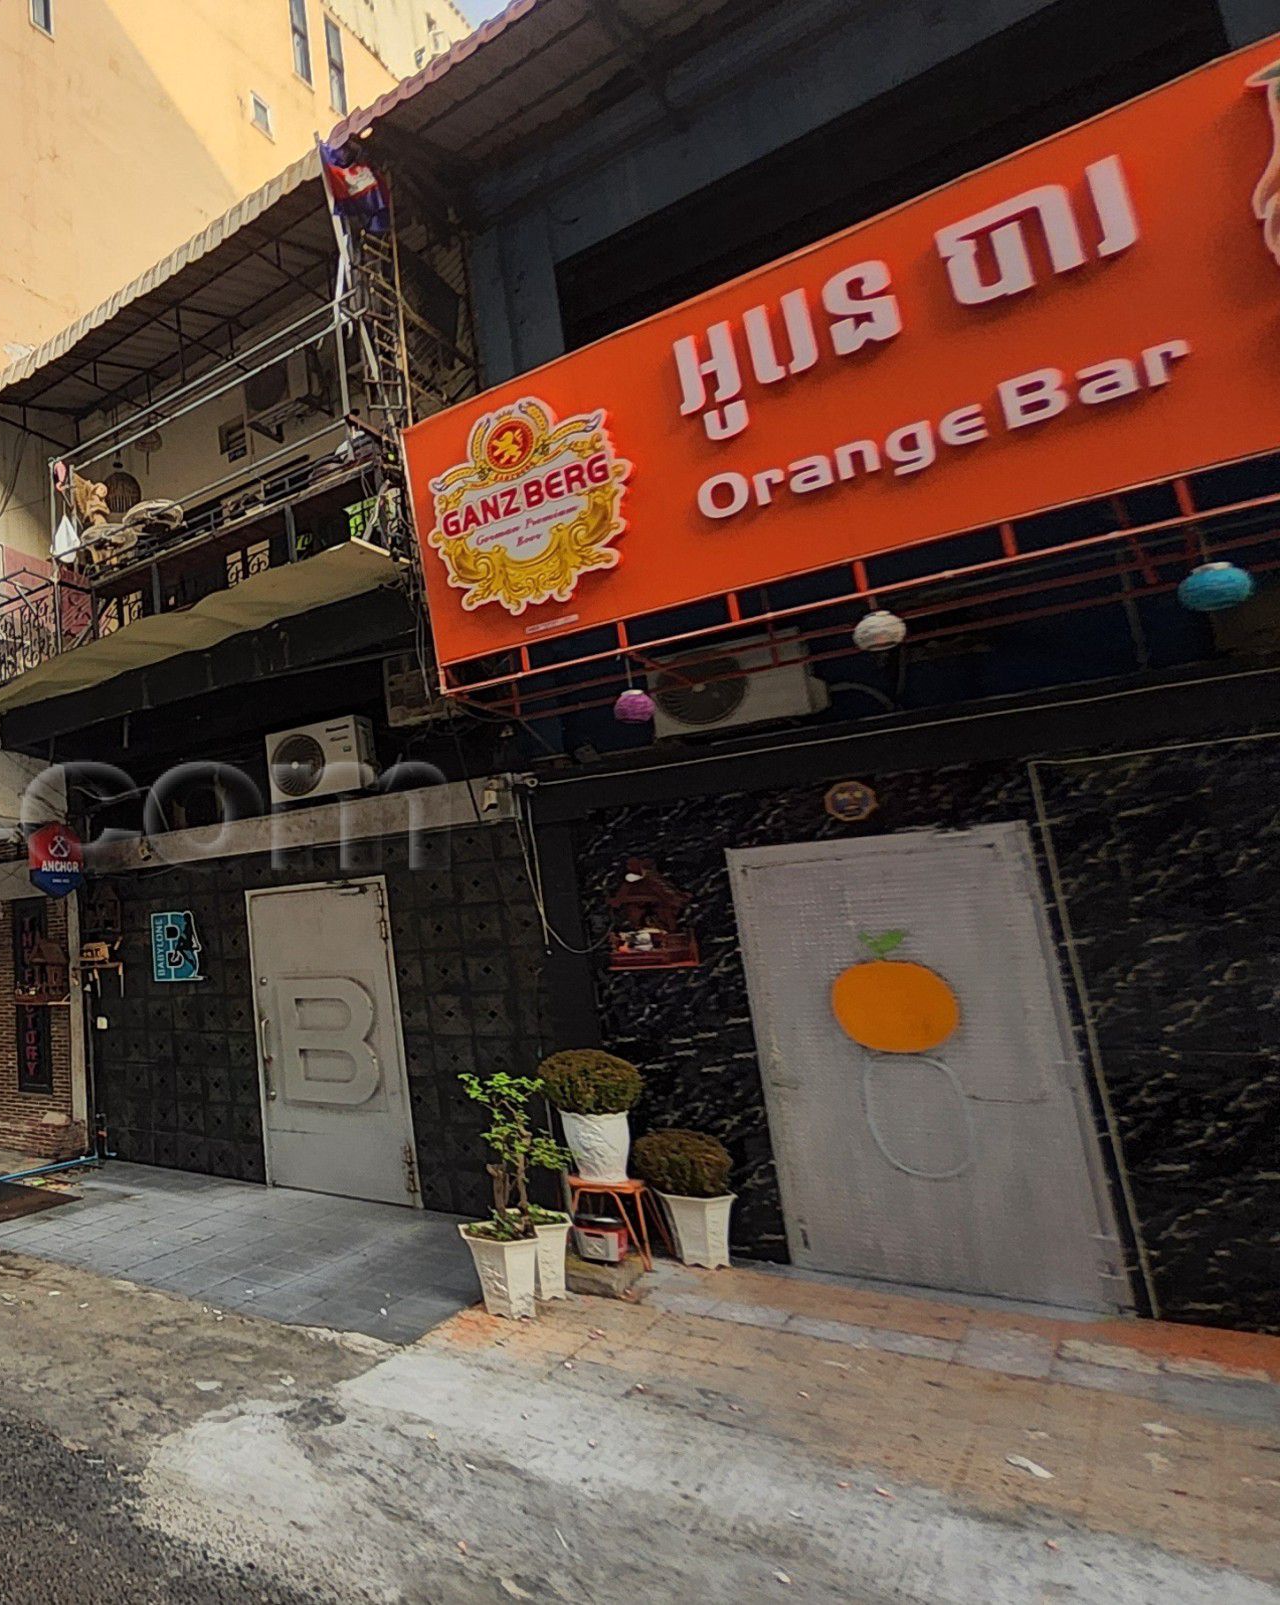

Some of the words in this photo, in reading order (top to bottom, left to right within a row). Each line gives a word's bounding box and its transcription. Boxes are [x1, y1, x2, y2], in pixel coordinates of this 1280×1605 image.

[934, 154, 1139, 306] បារ
[696, 403, 990, 519] Orange
[997, 338, 1192, 431] Bar
[41, 859, 79, 873] ANCHOR
[155, 918, 166, 977] BABYLONE
[277, 976, 381, 1105] B
